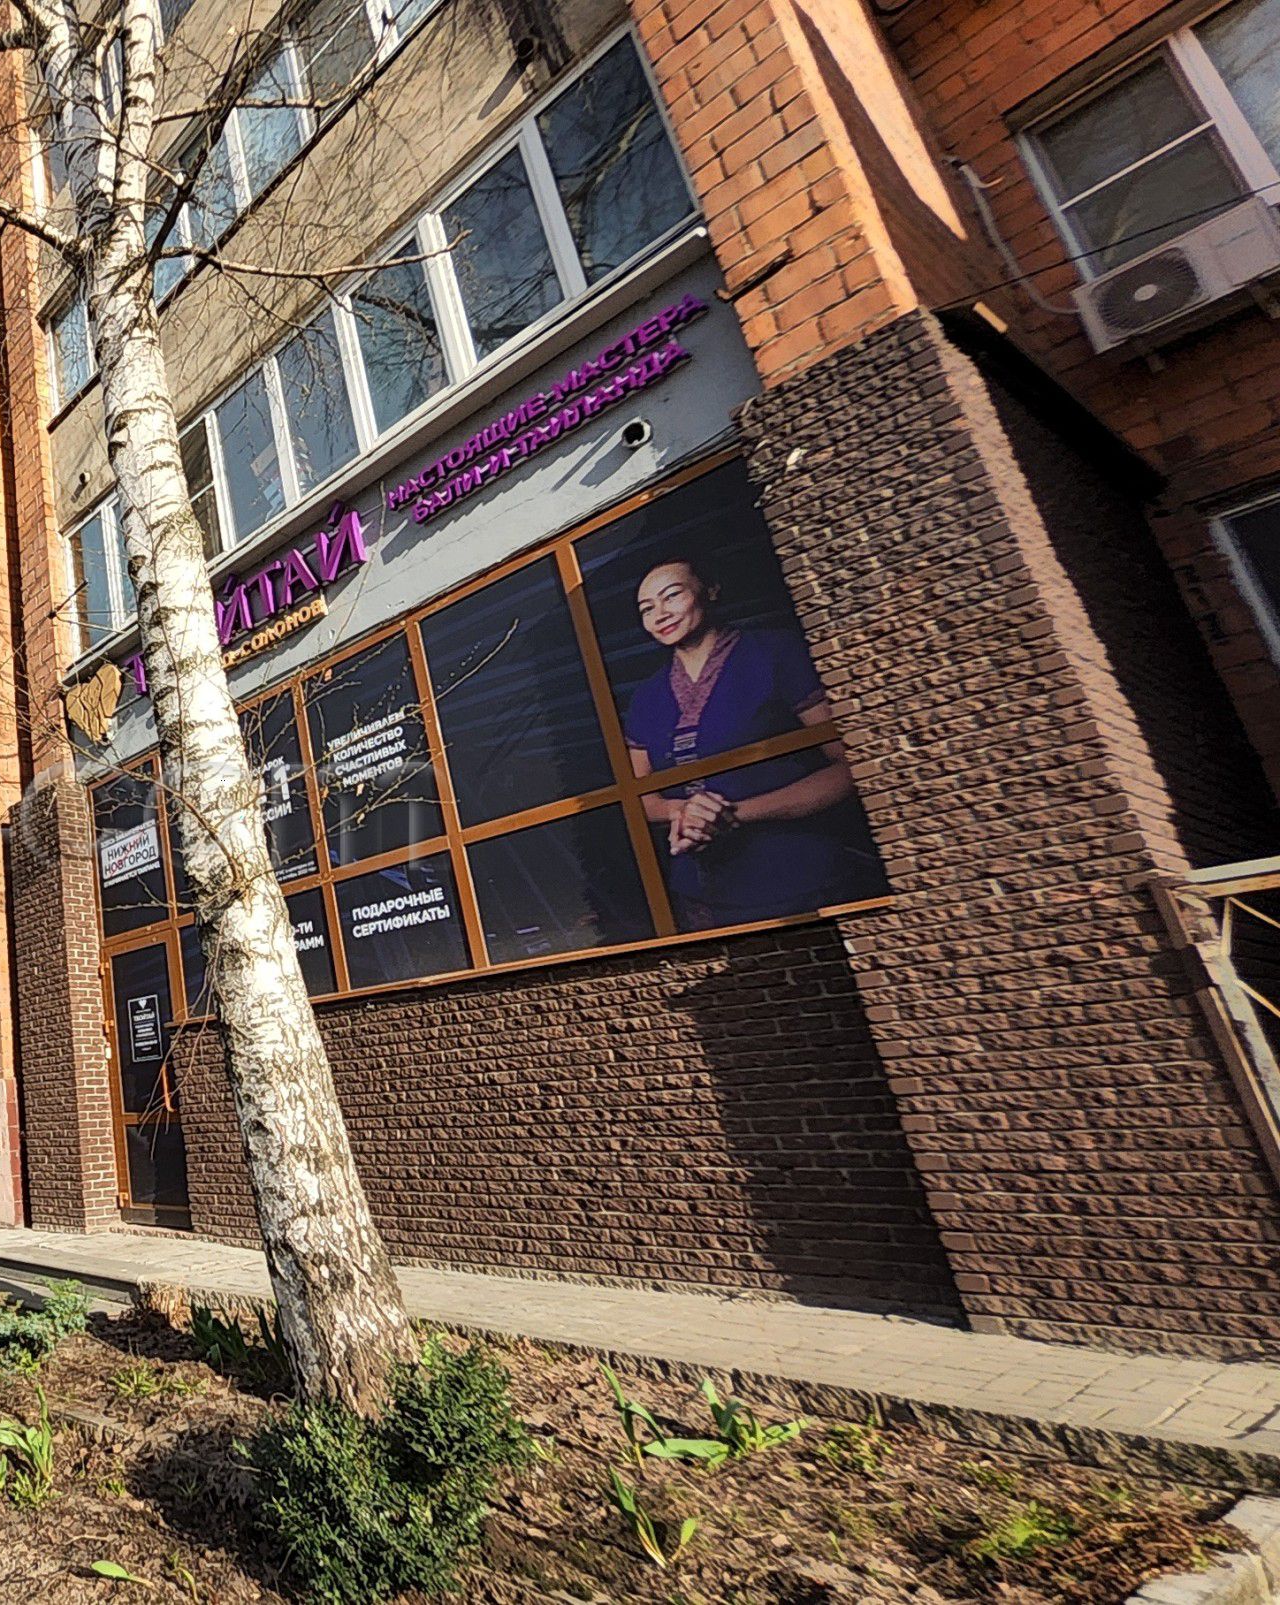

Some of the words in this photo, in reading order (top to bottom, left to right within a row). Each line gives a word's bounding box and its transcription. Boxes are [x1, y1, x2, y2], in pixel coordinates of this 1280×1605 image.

[387, 392, 549, 510] НАСТОЯЩИЕ
[551, 293, 707, 401] МАСТЕРА
[412, 464, 485, 524] БАЛИ
[487, 450, 515, 473] И
[517, 342, 692, 457] ТАИЛАНДА
[333, 726, 404, 763] КОЛИЧЕСТВО
[334, 739, 407, 776] СЧАСТЛИВЫХ
[342, 756, 404, 787] МОМЕНТОВ
[104, 845, 157, 876] НОВГОРОД
[107, 832, 150, 861] НИЖНИЙ
[352, 887, 444, 921] ПОДАРОЧНЫЕ
[352, 904, 450, 938] СЕРТИФИКАТЫ
